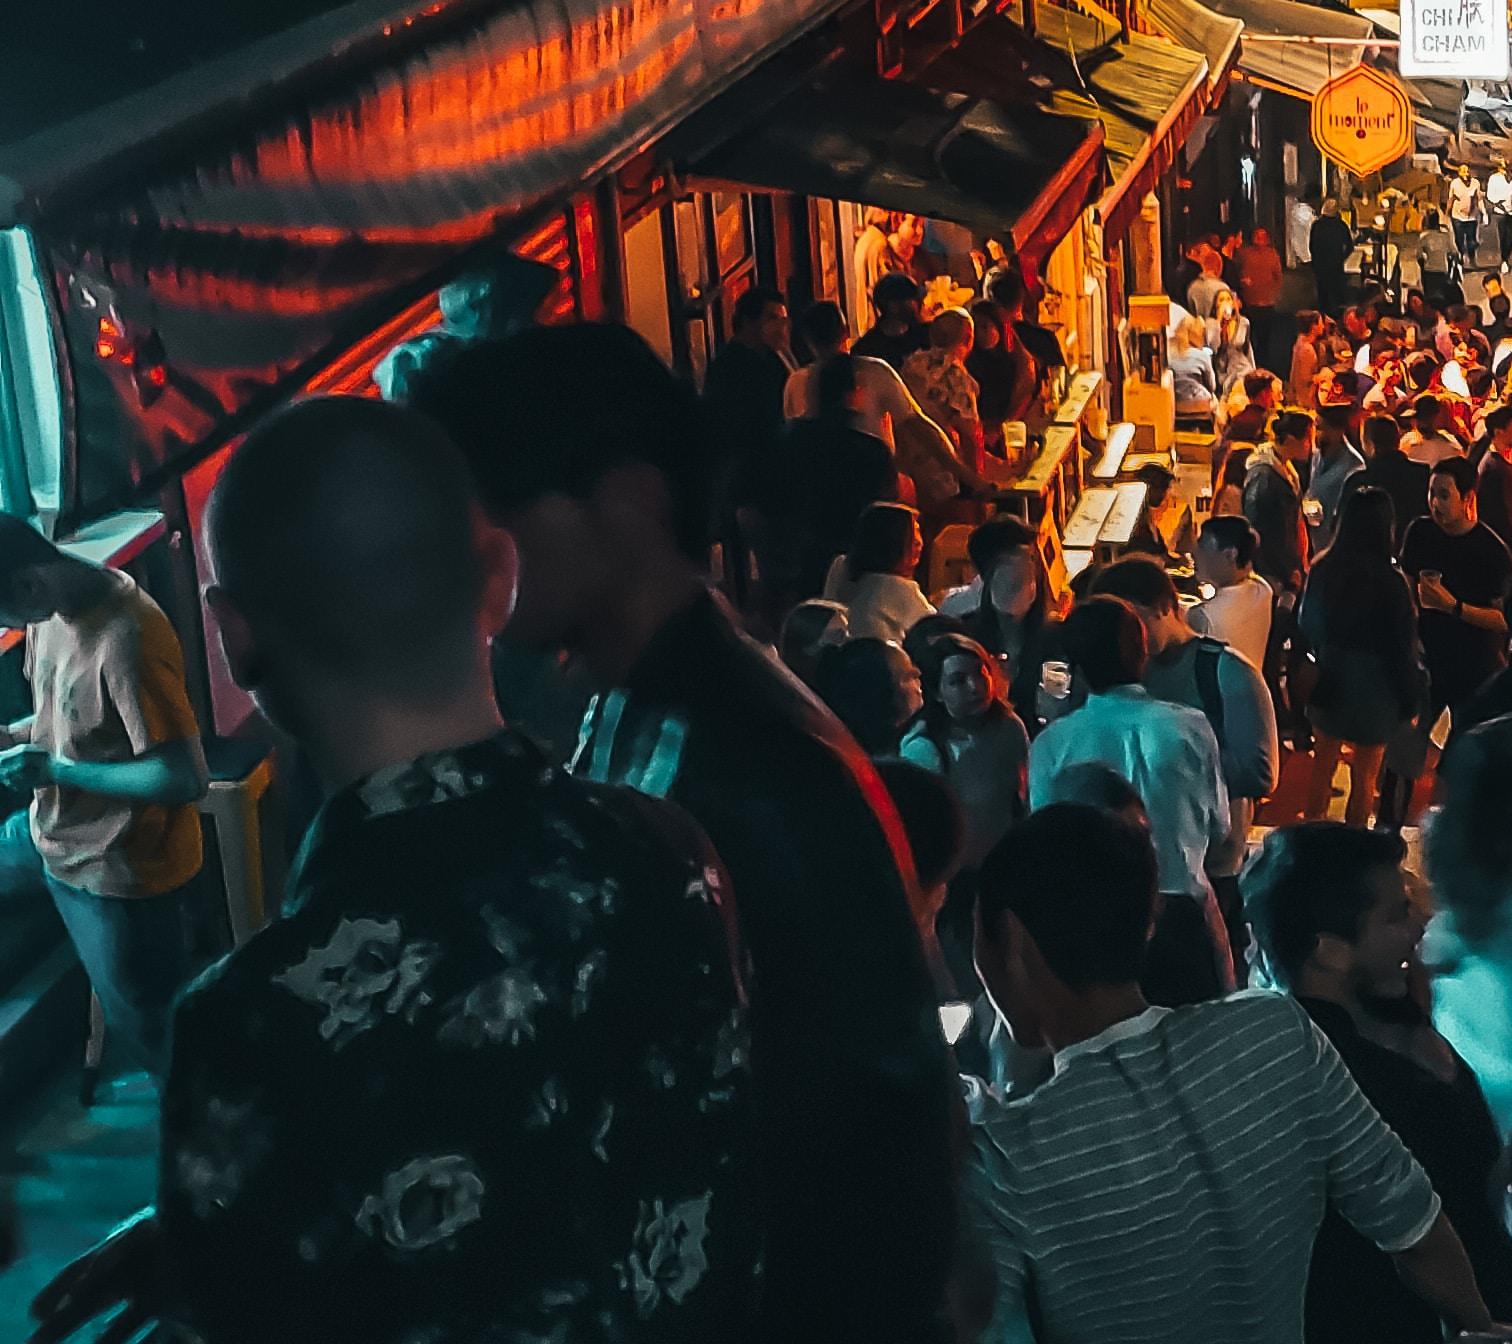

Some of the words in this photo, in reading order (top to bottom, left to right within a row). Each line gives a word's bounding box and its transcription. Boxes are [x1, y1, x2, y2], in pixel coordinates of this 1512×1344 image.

[1421, 8, 1452, 26] CHI
[1422, 35, 1485, 52] CHAM
[1329, 112, 1395, 129] moment
